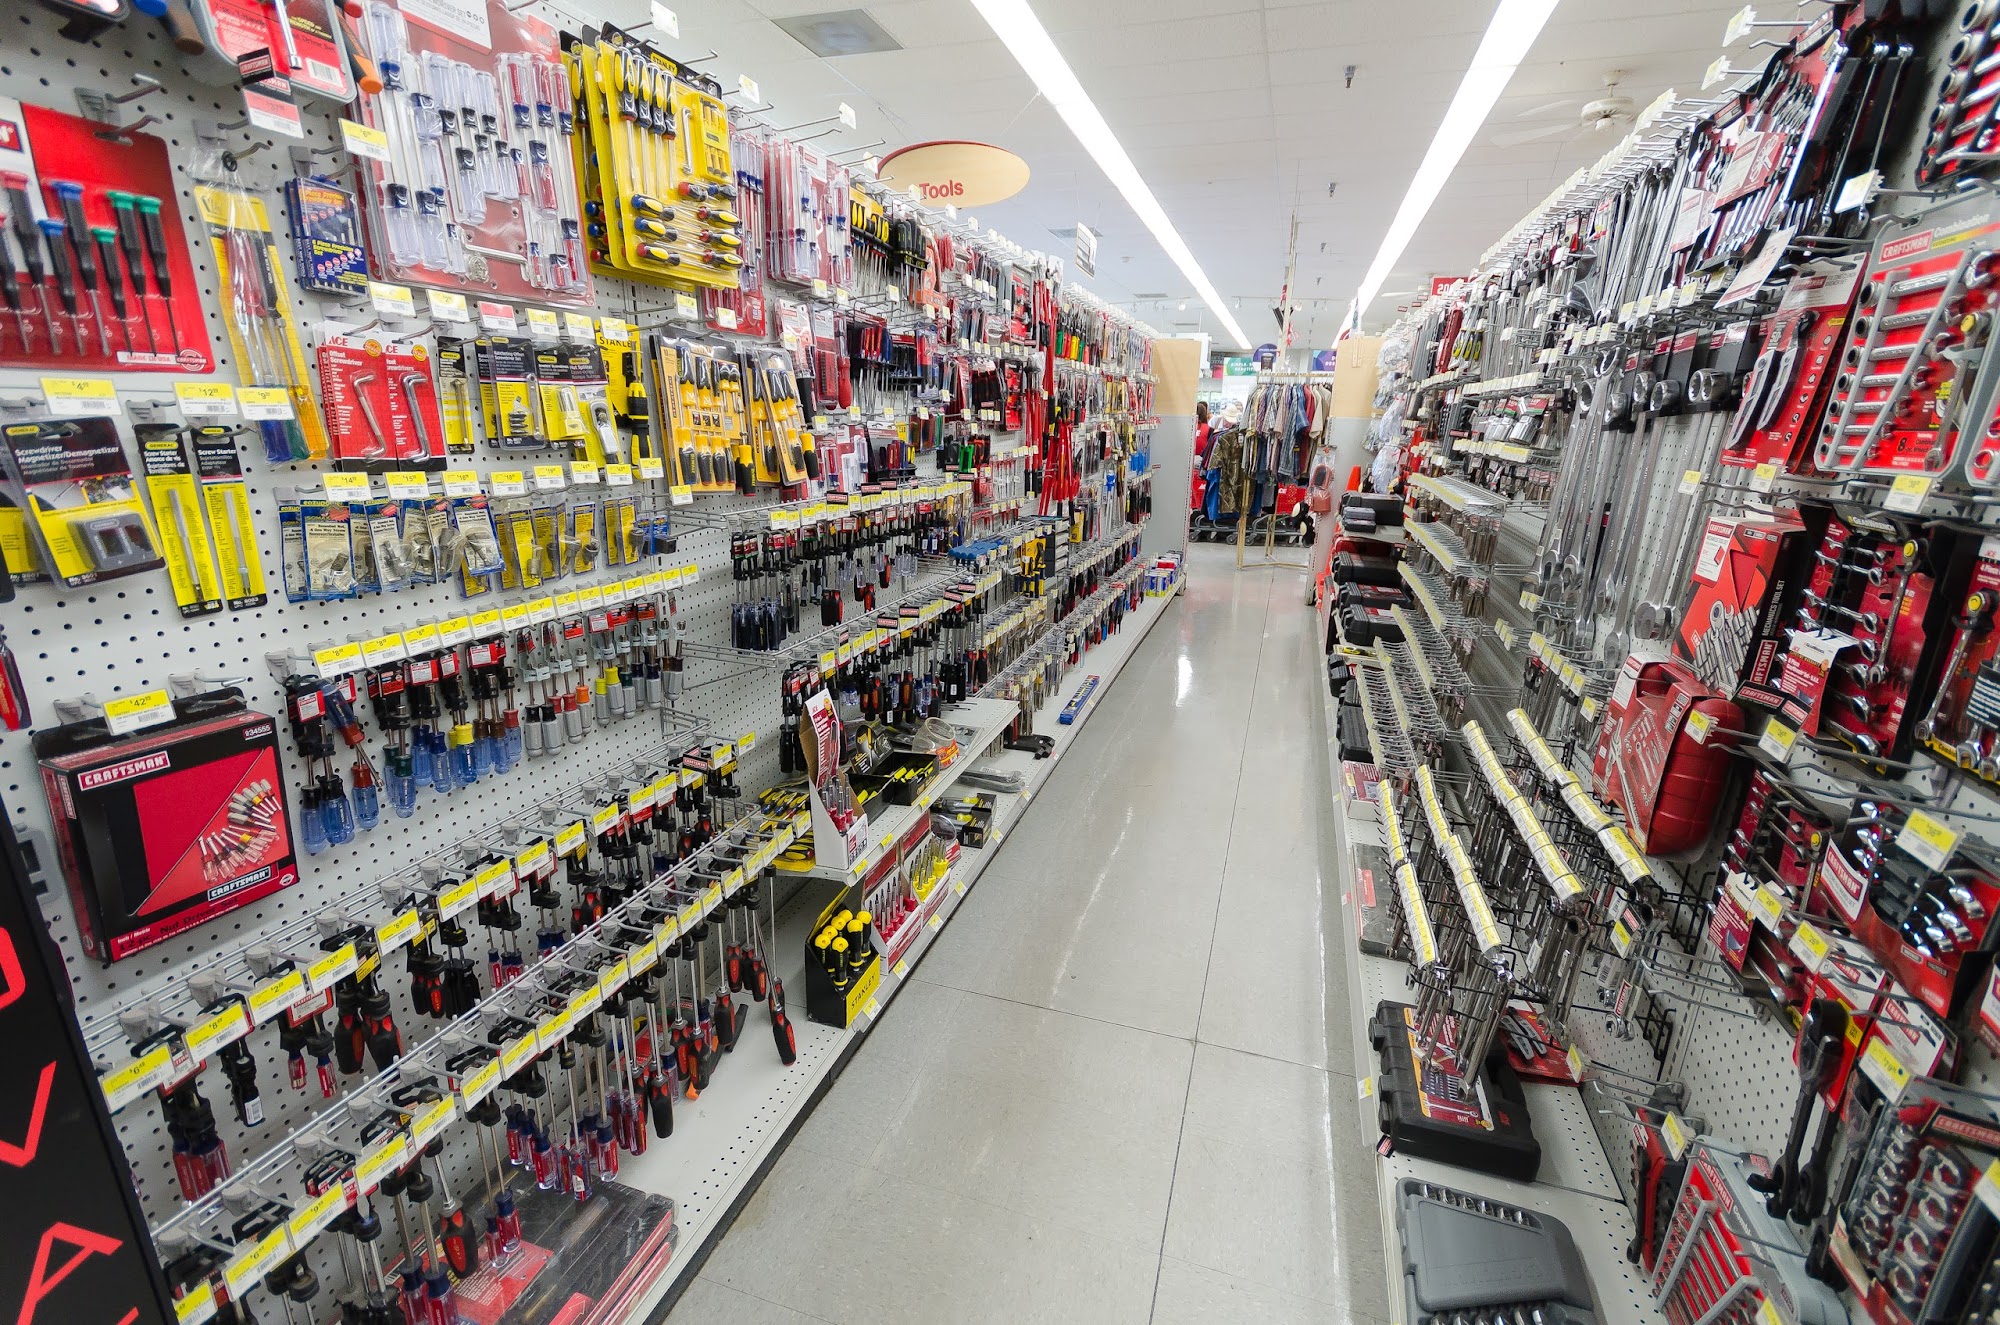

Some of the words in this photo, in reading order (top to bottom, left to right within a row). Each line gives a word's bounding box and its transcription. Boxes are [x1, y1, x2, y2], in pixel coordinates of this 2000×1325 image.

[652, 56, 676, 73] STANLEY
[919, 179, 964, 200] Tools
[1934, 213, 1990, 238] Combination
[1882, 235, 1931, 259] CRAFTSMAN
[329, 336, 348, 347] ACE
[385, 345, 398, 354] CE
[599, 335, 637, 348] STANLE
[15, 445, 63, 456] Screwdriver
[1897, 437, 1908, 452] 8
[18, 446, 119, 464] Magnetizer/Demagnetizer
[1775, 580, 1786, 591] SET
[1772, 590, 1782, 604] TOOL
[1761, 604, 1778, 636] MECHANICS
[1754, 642, 1773, 682] AFTSMAN
[1741, 688, 1780, 704] CRAFTSMAN
[84, 755, 166, 786] CRAFTSMAN
[684, 758, 706, 767] CRAFTSMAN
[1828, 848, 1861, 895] CRAFTSMAN
[210, 867, 267, 897] CRAFTSMAN
[119, 940, 136, 951] 12
[160, 923, 180, 935] Nut
[183, 908, 216, 925] Driver
[221, 898, 239, 908] Set
[851, 974, 875, 1010] STANLEY
